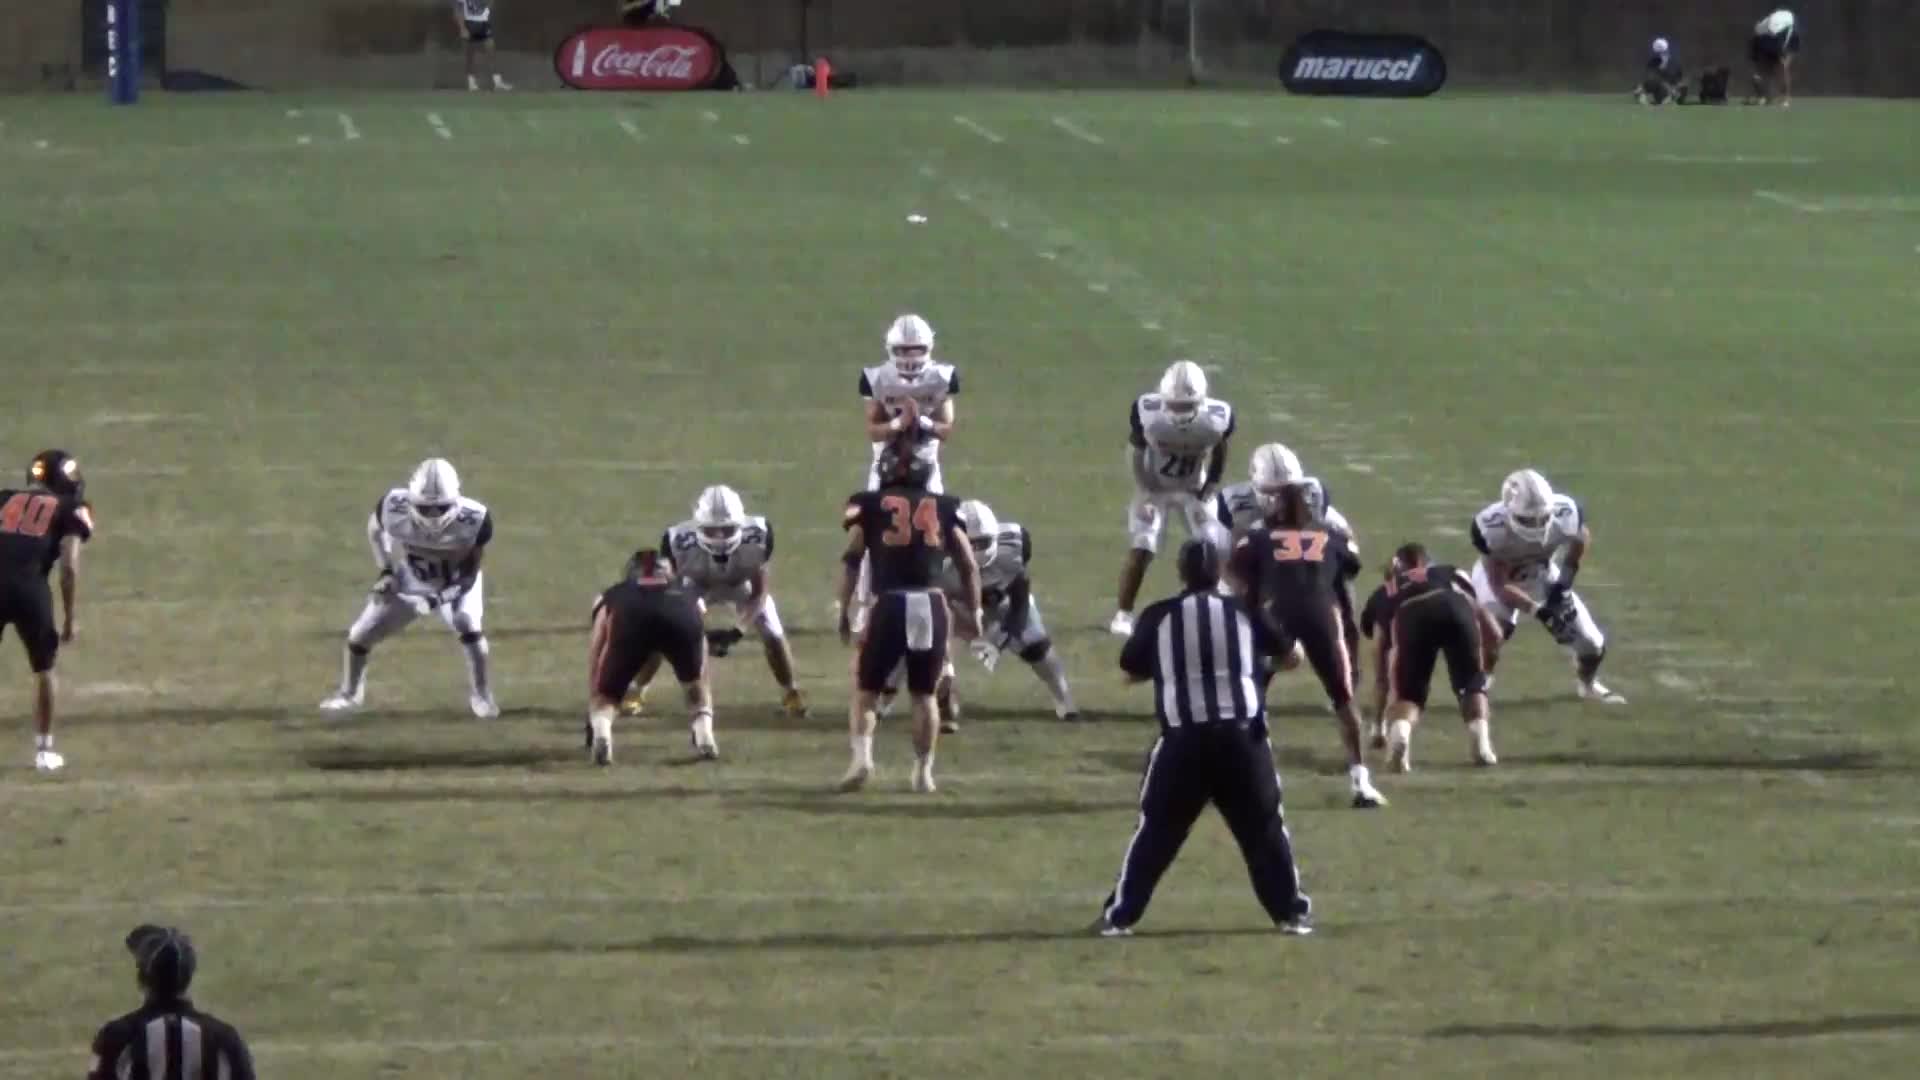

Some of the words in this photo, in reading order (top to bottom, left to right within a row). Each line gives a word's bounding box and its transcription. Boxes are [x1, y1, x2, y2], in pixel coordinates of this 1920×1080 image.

[1294, 54, 1422, 81] marucci
[0, 493, 58, 537] 40
[881, 496, 940, 546] 34
[1270, 529, 1329, 563] 37
